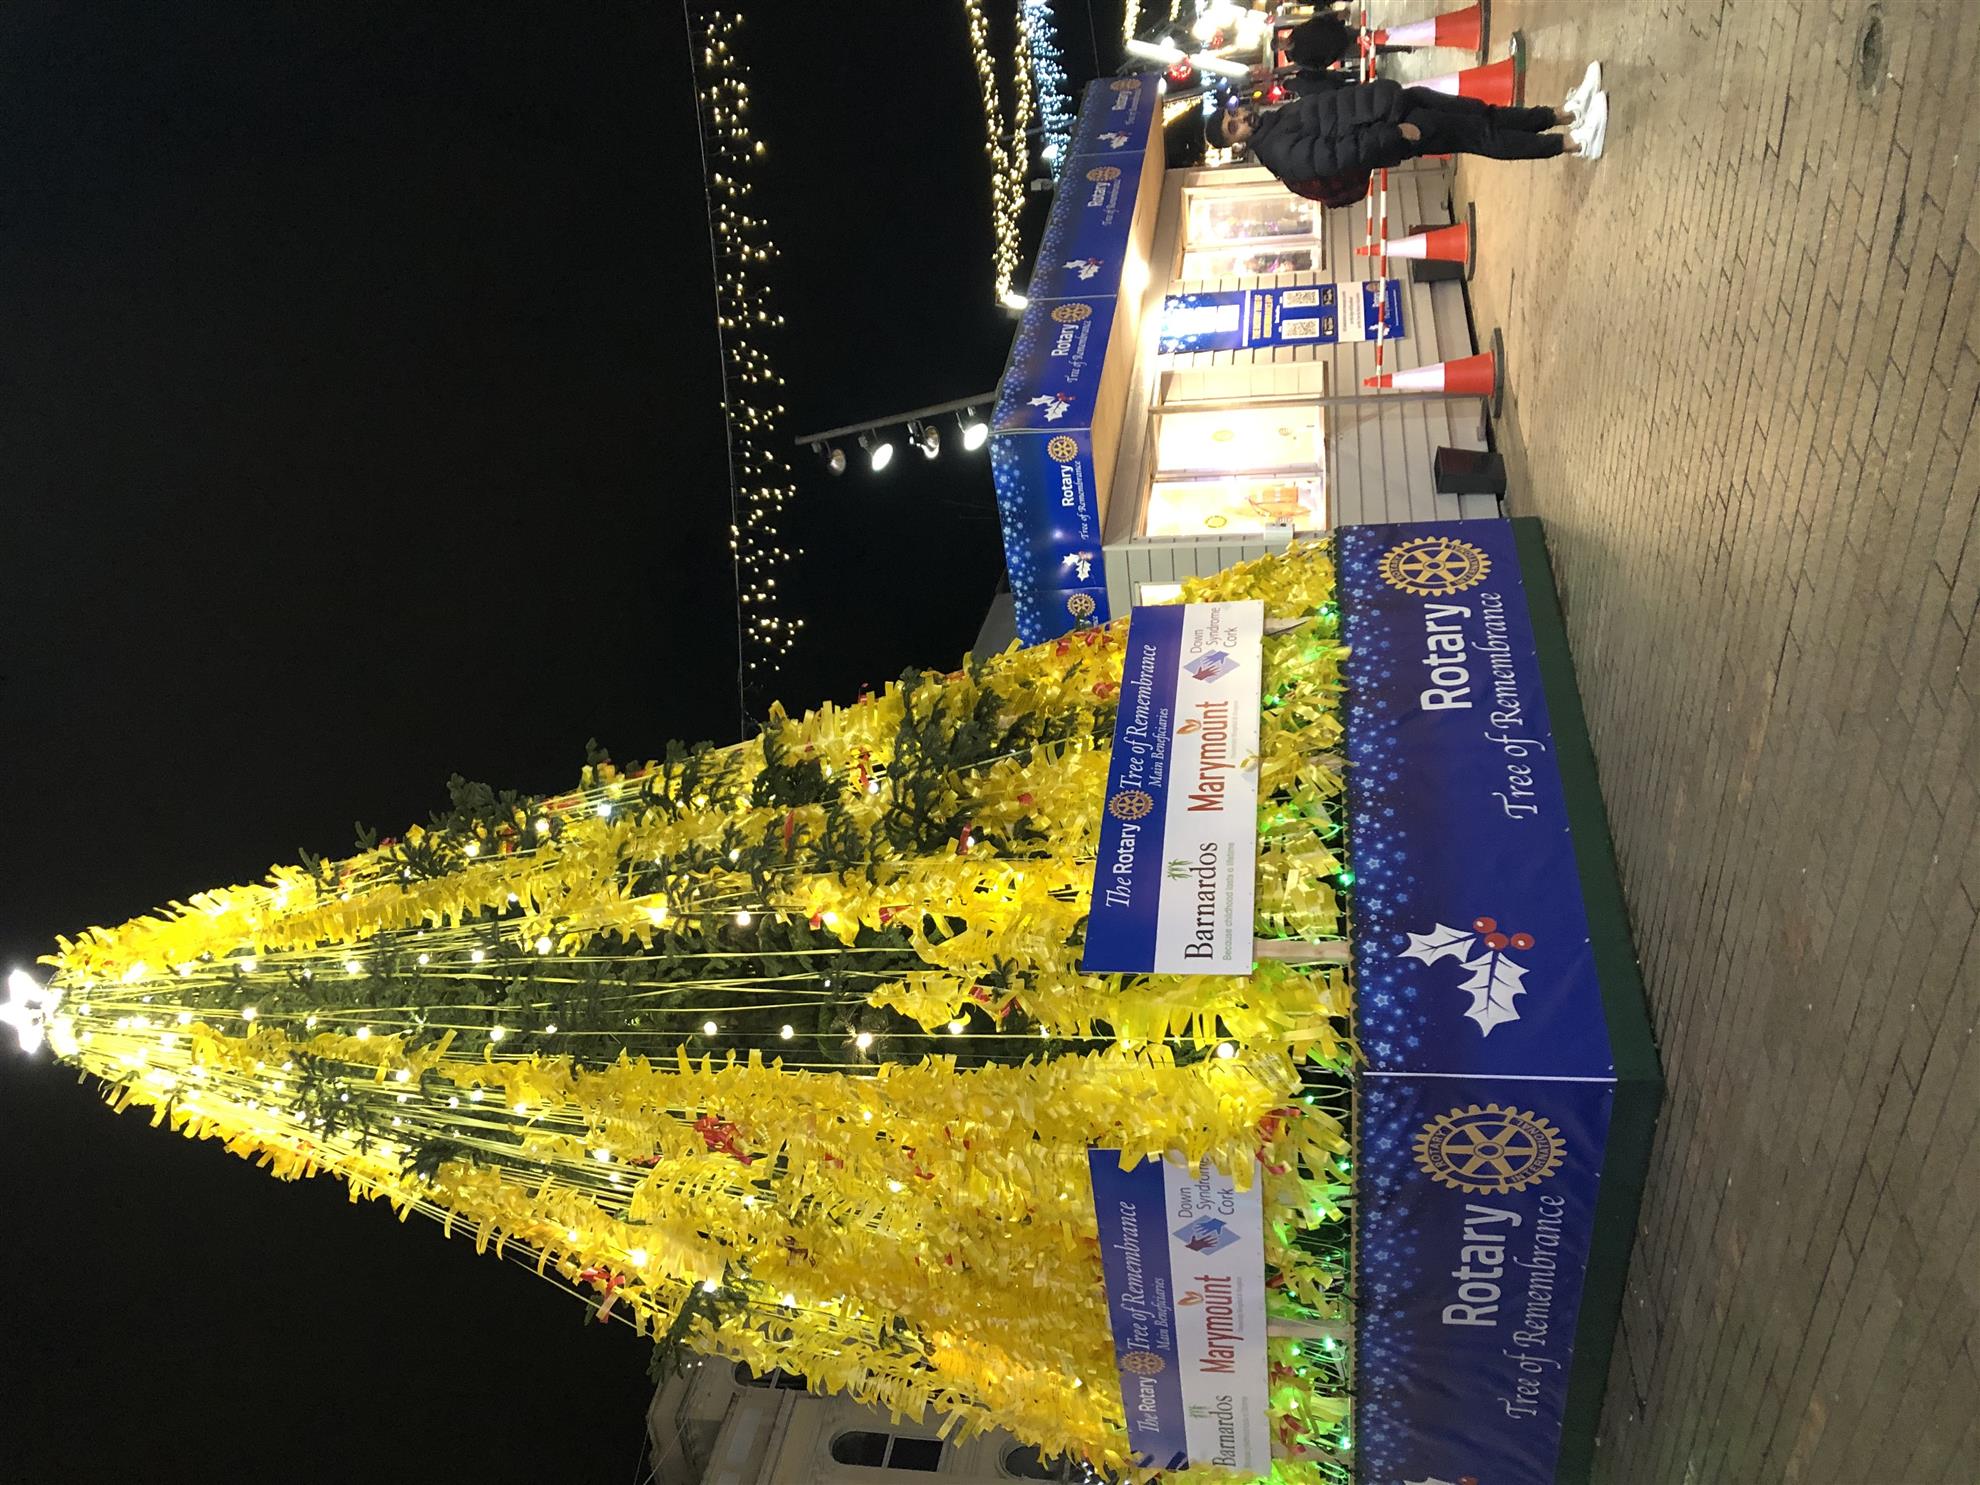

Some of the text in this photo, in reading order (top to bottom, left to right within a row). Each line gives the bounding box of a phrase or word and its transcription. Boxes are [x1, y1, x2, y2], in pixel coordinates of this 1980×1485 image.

[1051, 324, 1079, 356] Rotary
[1060, 464, 1074, 506] Rotary
[1076, 512, 1092, 522] of
[1080, 524, 1090, 540] Tree
[1190, 629, 1204, 654] Down
[1206, 606, 1222, 645] Syndrome
[1223, 626, 1238, 648] Cork
[1420, 603, 1472, 711] Rotary
[1472, 592, 1546, 820] Tree of Remembrance
[1105, 644, 1157, 908] The Rotary Tree of Remembrance
[1148, 708, 1170, 788] Main Beneficiaries
[1187, 700, 1236, 812] Marymount
[1184, 842, 1218, 960] Barnardos
[1428, 1128, 1447, 1168] ROTARY
[1510, 1117, 1550, 1182] INTERNATIONAL
[1178, 1187, 1193, 1218] Down
[1217, 1188, 1234, 1216] Cork
[1442, 1204, 1522, 1327] Rotary
[1113, 1200, 1159, 1432] The Rotary Tree of Remembrance
[1194, 1274, 1244, 1374] Marymount
[1498, 1194, 1566, 1420] Tree of Remembrance
[1209, 1395, 1236, 1467] Barnardos
